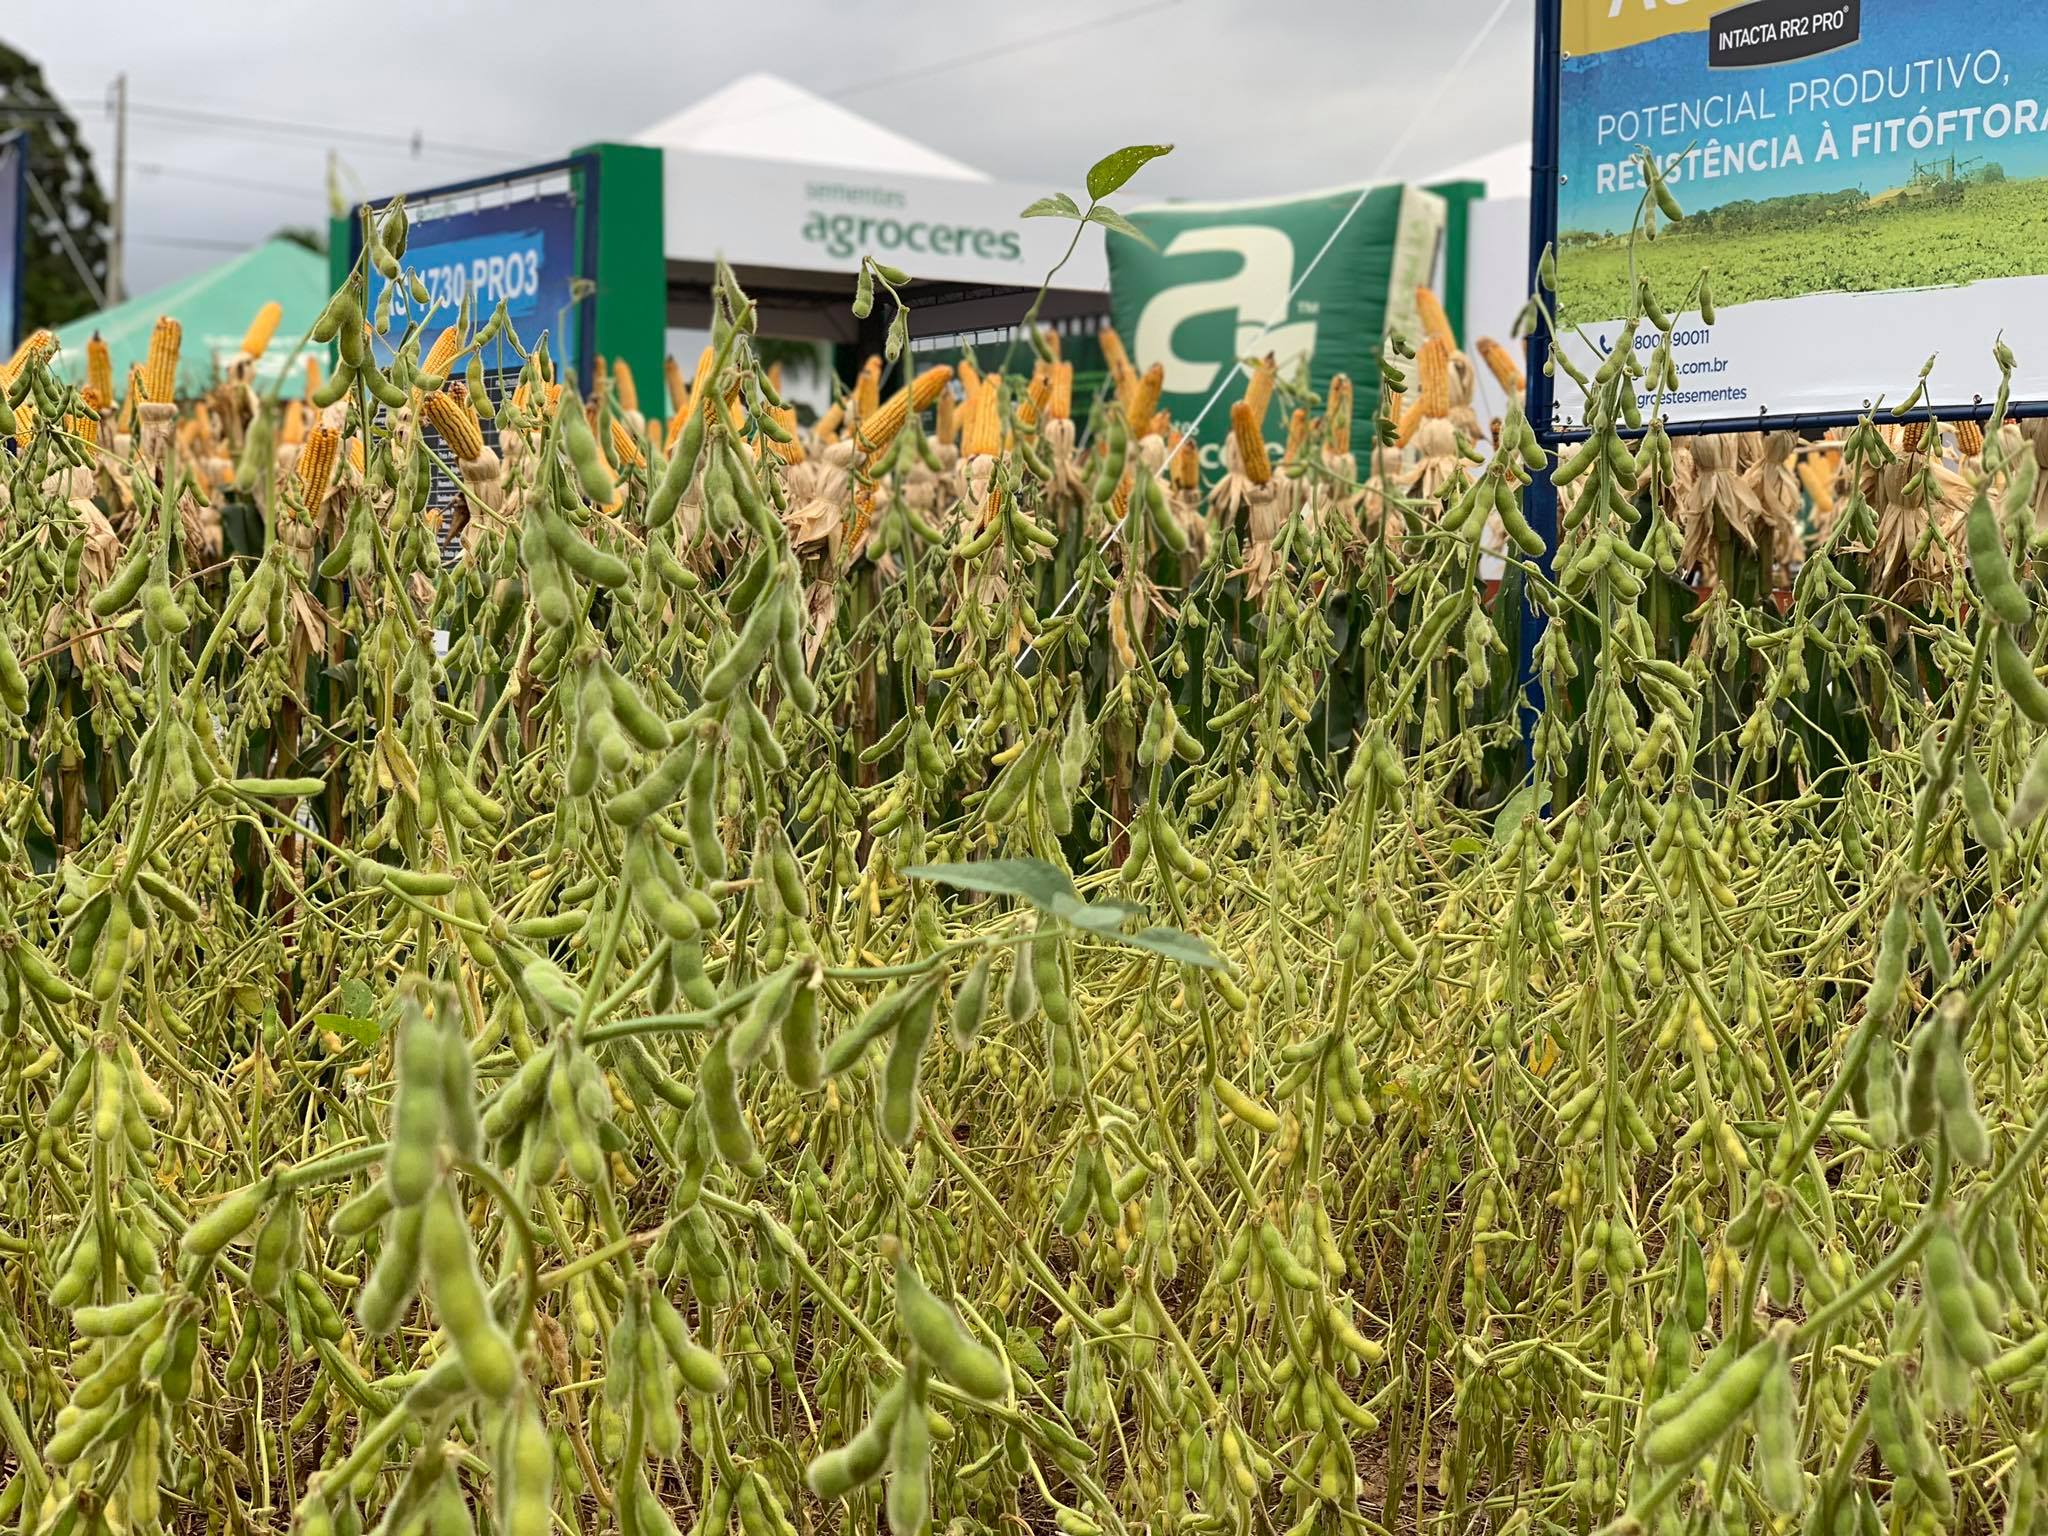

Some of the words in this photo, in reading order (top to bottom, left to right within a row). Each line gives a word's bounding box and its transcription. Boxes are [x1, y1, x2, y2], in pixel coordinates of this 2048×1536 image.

[1718, 23, 1777, 51] INTACTA
[1780, 16, 1809, 40] RR2
[1597, 87, 1776, 145] POTENCIAL
[1788, 49, 2010, 116] PRODUTIVO,
[1814, 120, 1840, 162] À
[802, 210, 1022, 262] agroceres
[472, 248, 540, 302] PRO3
[1632, 329, 1710, 350] 80090011
[1637, 386, 1747, 409] groestesementes
